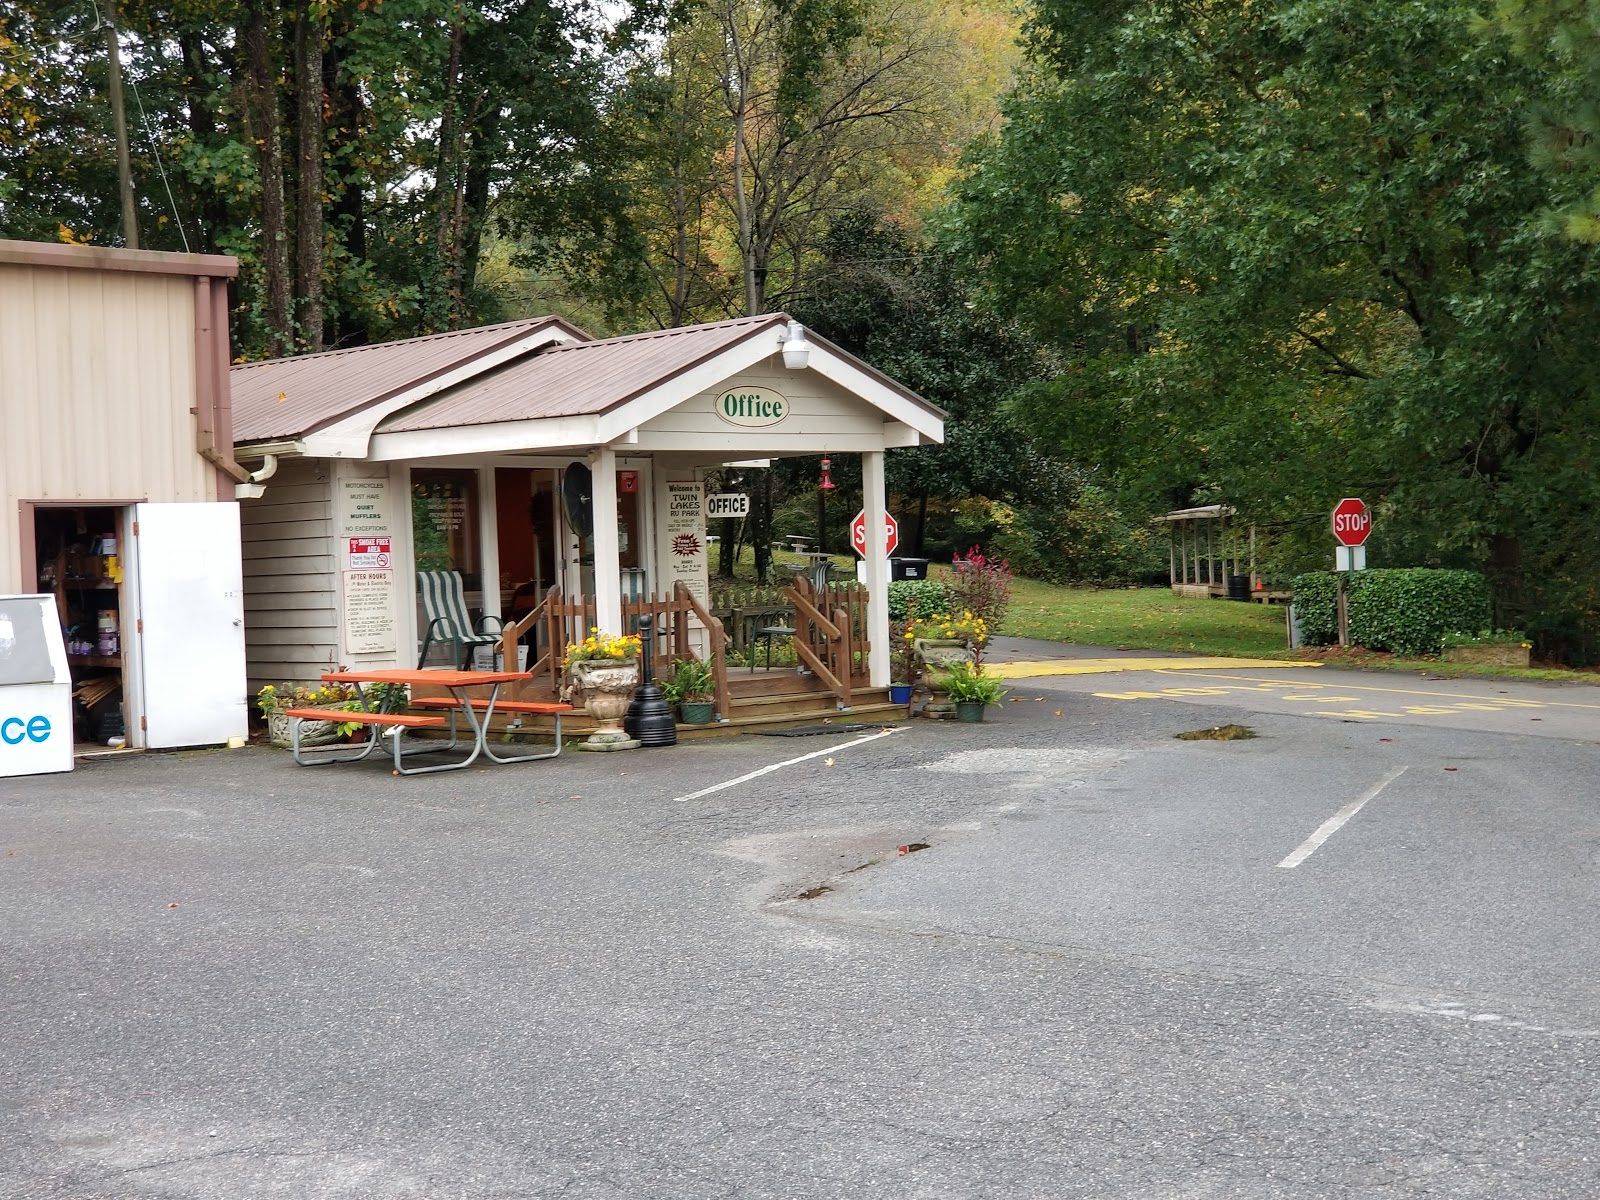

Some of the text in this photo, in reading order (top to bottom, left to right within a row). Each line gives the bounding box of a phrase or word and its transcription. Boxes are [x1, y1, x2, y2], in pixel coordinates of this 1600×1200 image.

[724, 394, 782, 417] Office
[708, 498, 746, 513] OFFICE
[1336, 514, 1368, 531] STOP
[855, 525, 894, 544] SP
[1, 715, 52, 745] ce
